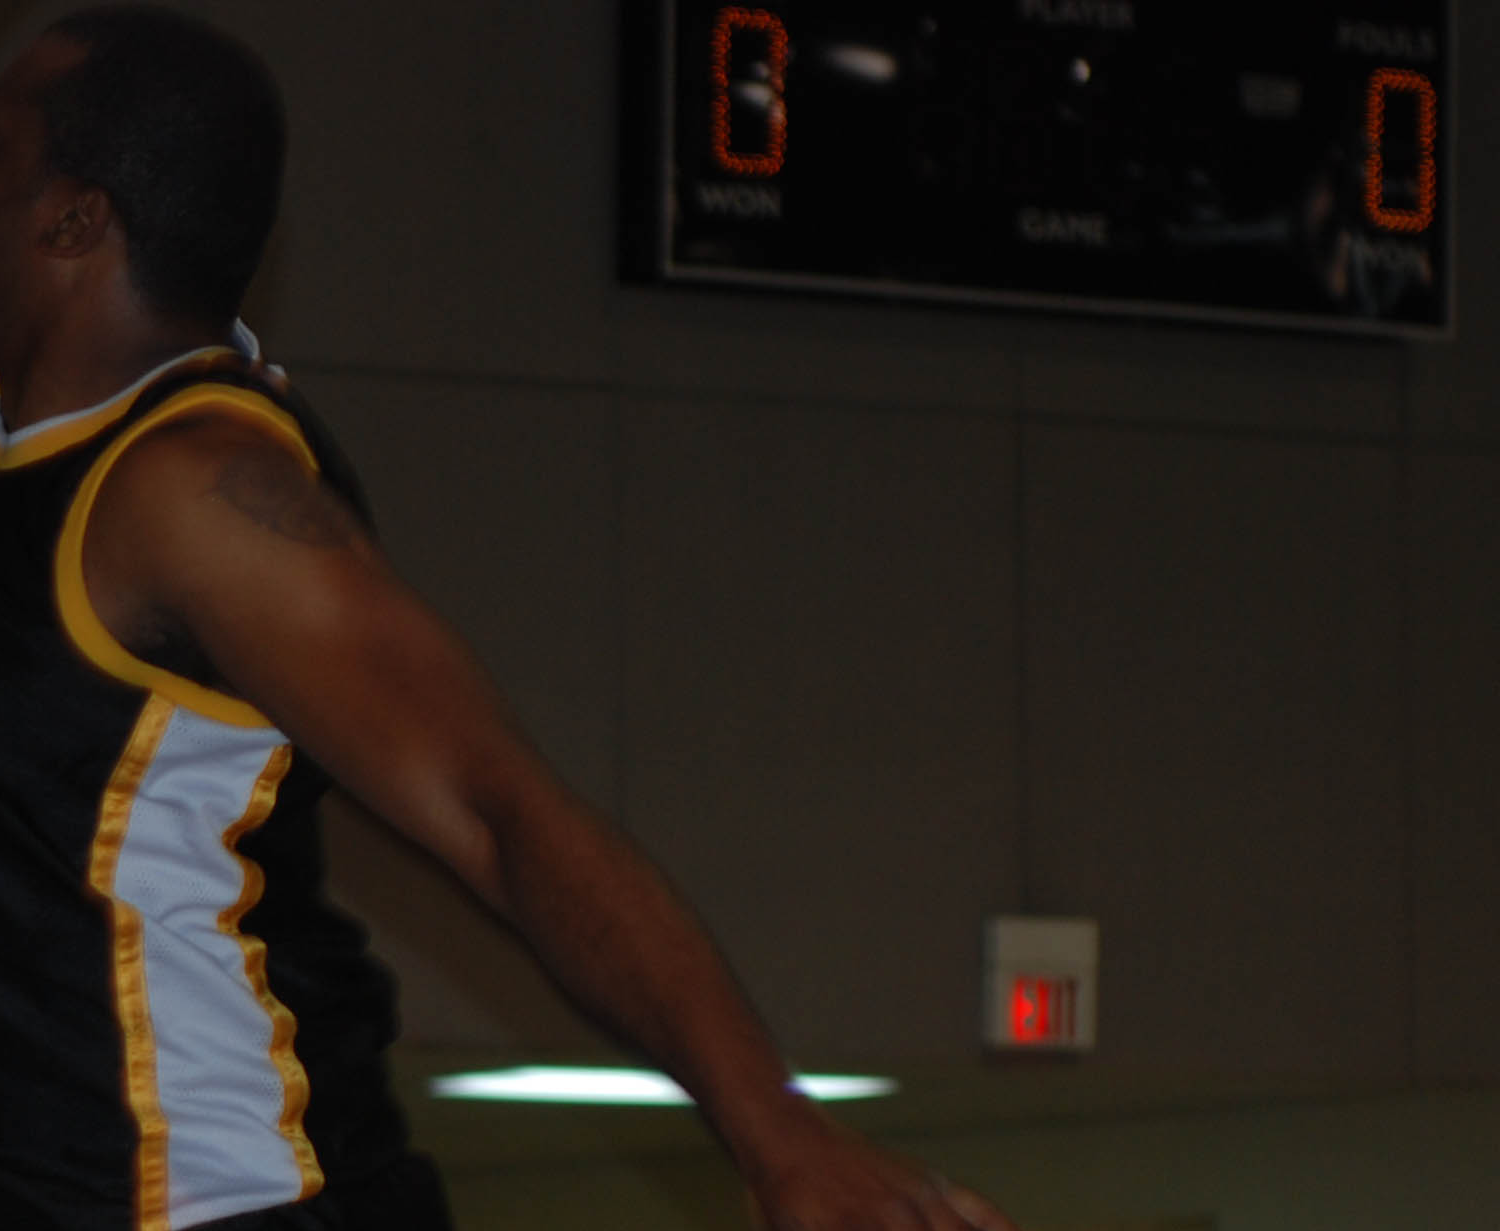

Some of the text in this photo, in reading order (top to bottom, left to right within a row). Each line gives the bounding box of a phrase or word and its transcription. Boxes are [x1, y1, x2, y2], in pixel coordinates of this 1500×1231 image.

[1334, 17, 1437, 60] FOULS
[1364, 66, 1437, 232] 0
[695, 182, 783, 220] WON
[1014, 205, 1110, 246] GAME
[1010, 974, 1079, 1043] EXIT
